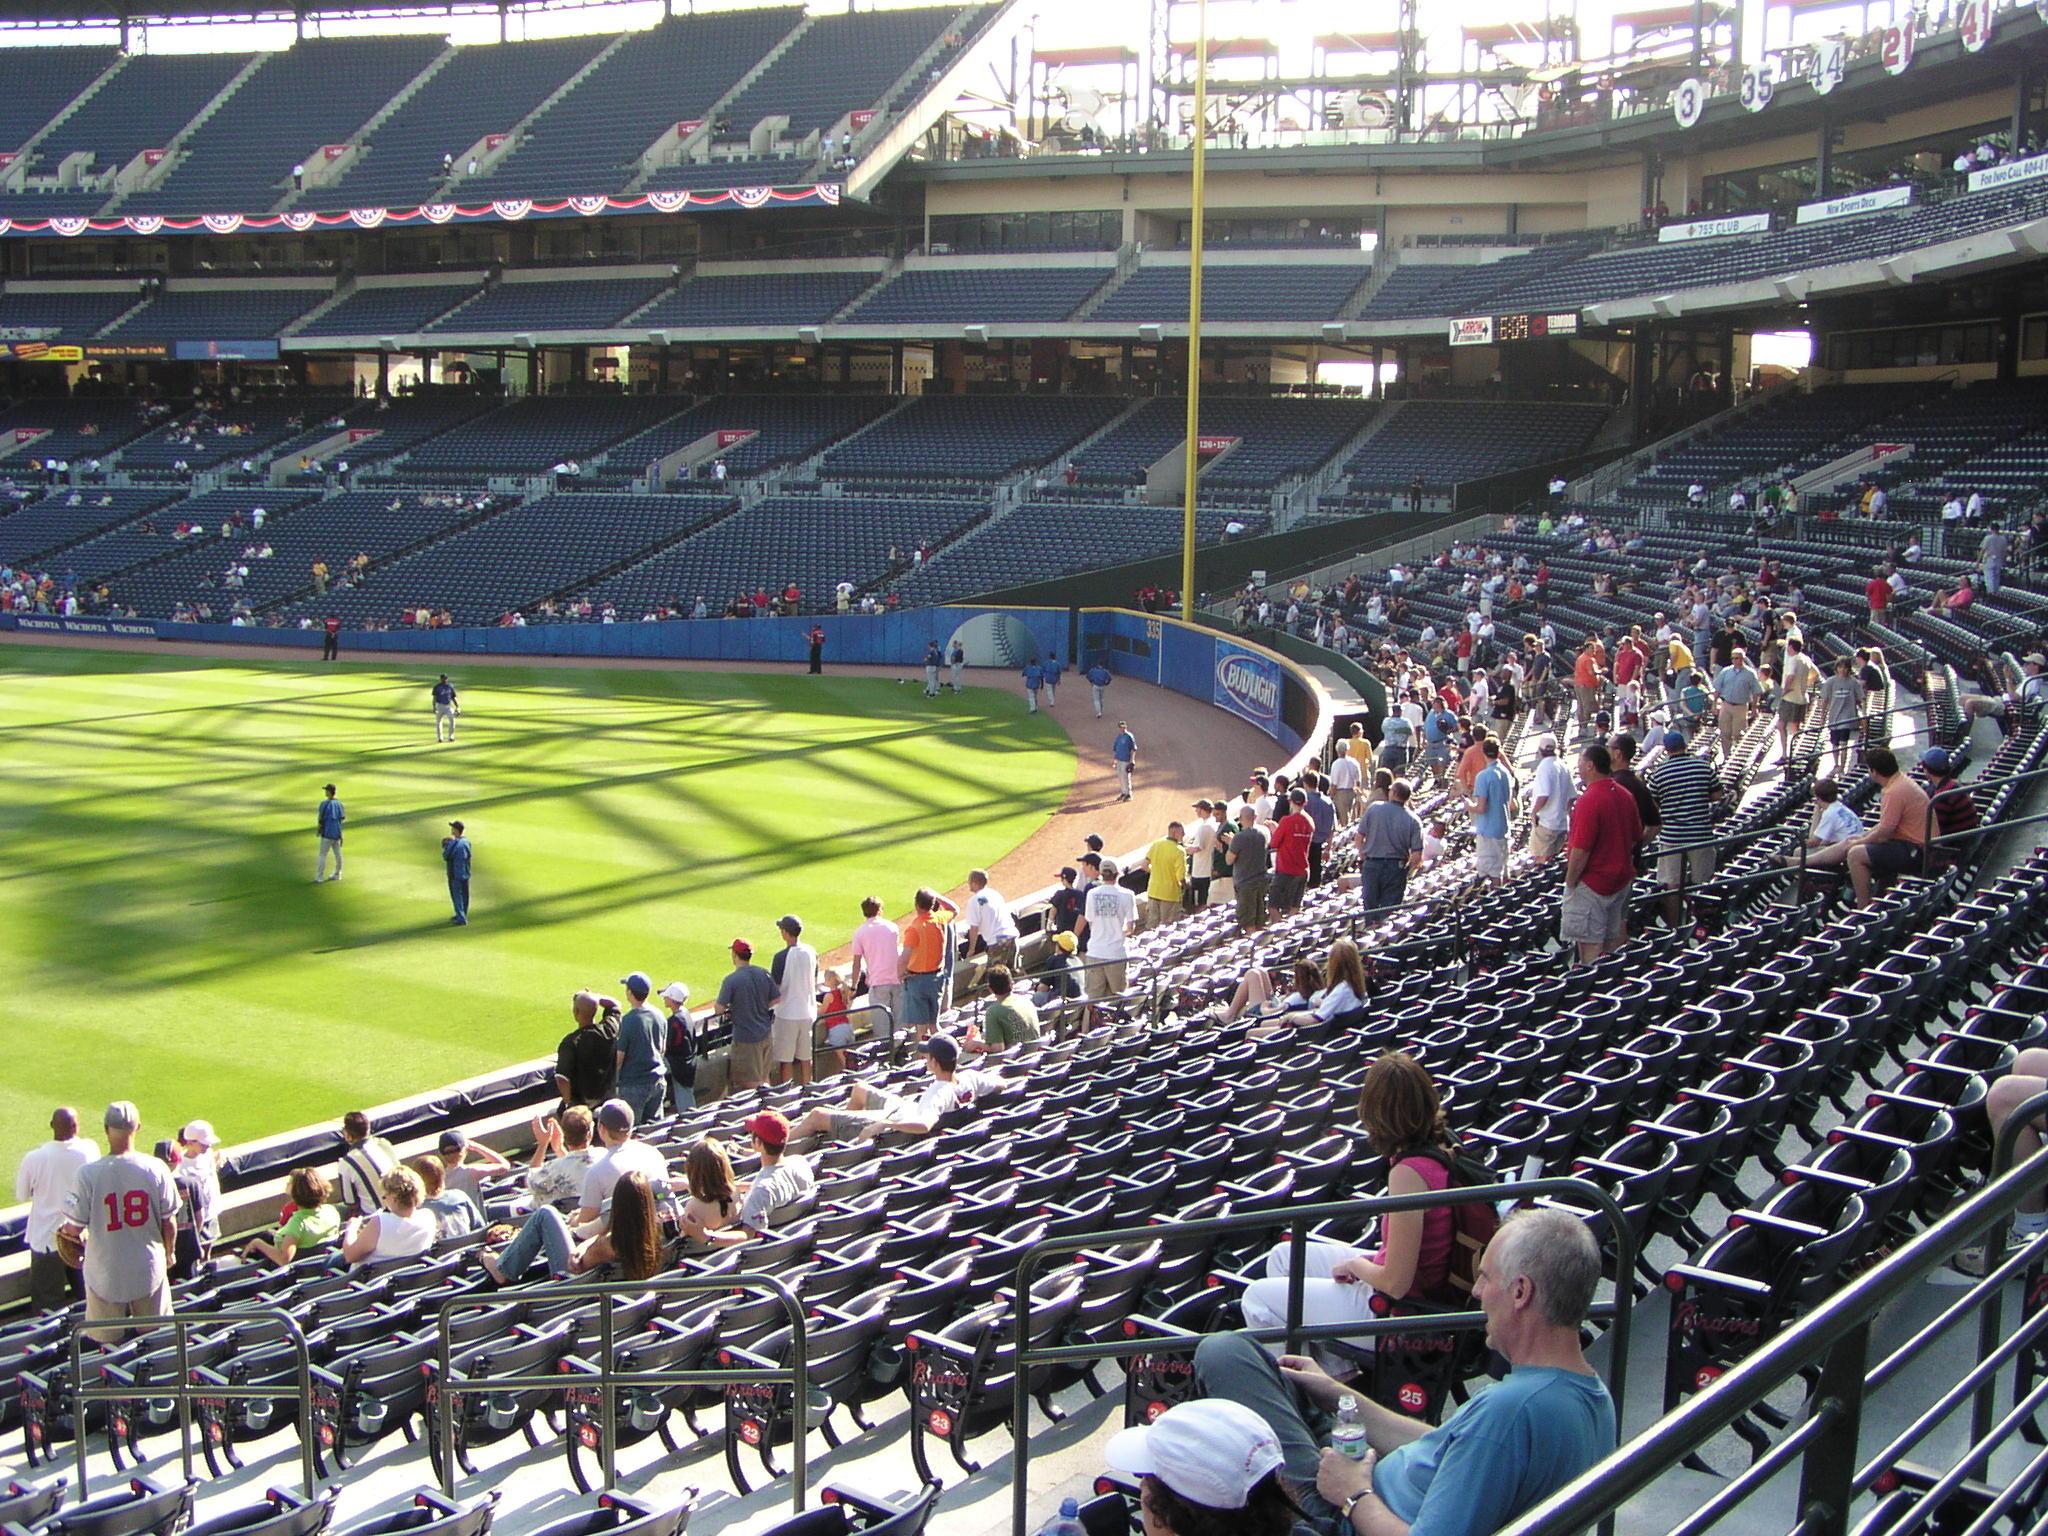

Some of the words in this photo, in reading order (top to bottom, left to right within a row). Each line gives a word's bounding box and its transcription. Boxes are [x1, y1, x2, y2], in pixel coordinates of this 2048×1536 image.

[1961, 0, 1991, 44] 41
[1884, 22, 1914, 67] 21
[1809, 46, 1841, 87] 44
[1742, 70, 1774, 104] 35
[1682, 89, 1694, 117] 3
[1698, 224, 1713, 235] 755
[1715, 221, 1740, 233] CLUB
[18, 618, 60, 629] WACHOVIA
[64, 621, 107, 632] WACHOVIA
[112, 623, 155, 634] WACHOVIA
[1146, 619, 1160, 640] 335
[1227, 663, 1250, 694] BUD
[1249, 673, 1277, 709] LIGHT
[104, 1190, 149, 1232] 18
[912, 1360, 967, 1388] Braves
[1400, 1388, 1423, 1406] 25
[581, 1428, 594, 1442] 21
[743, 1424, 758, 1440] 22
[932, 1414, 949, 1430] 23
